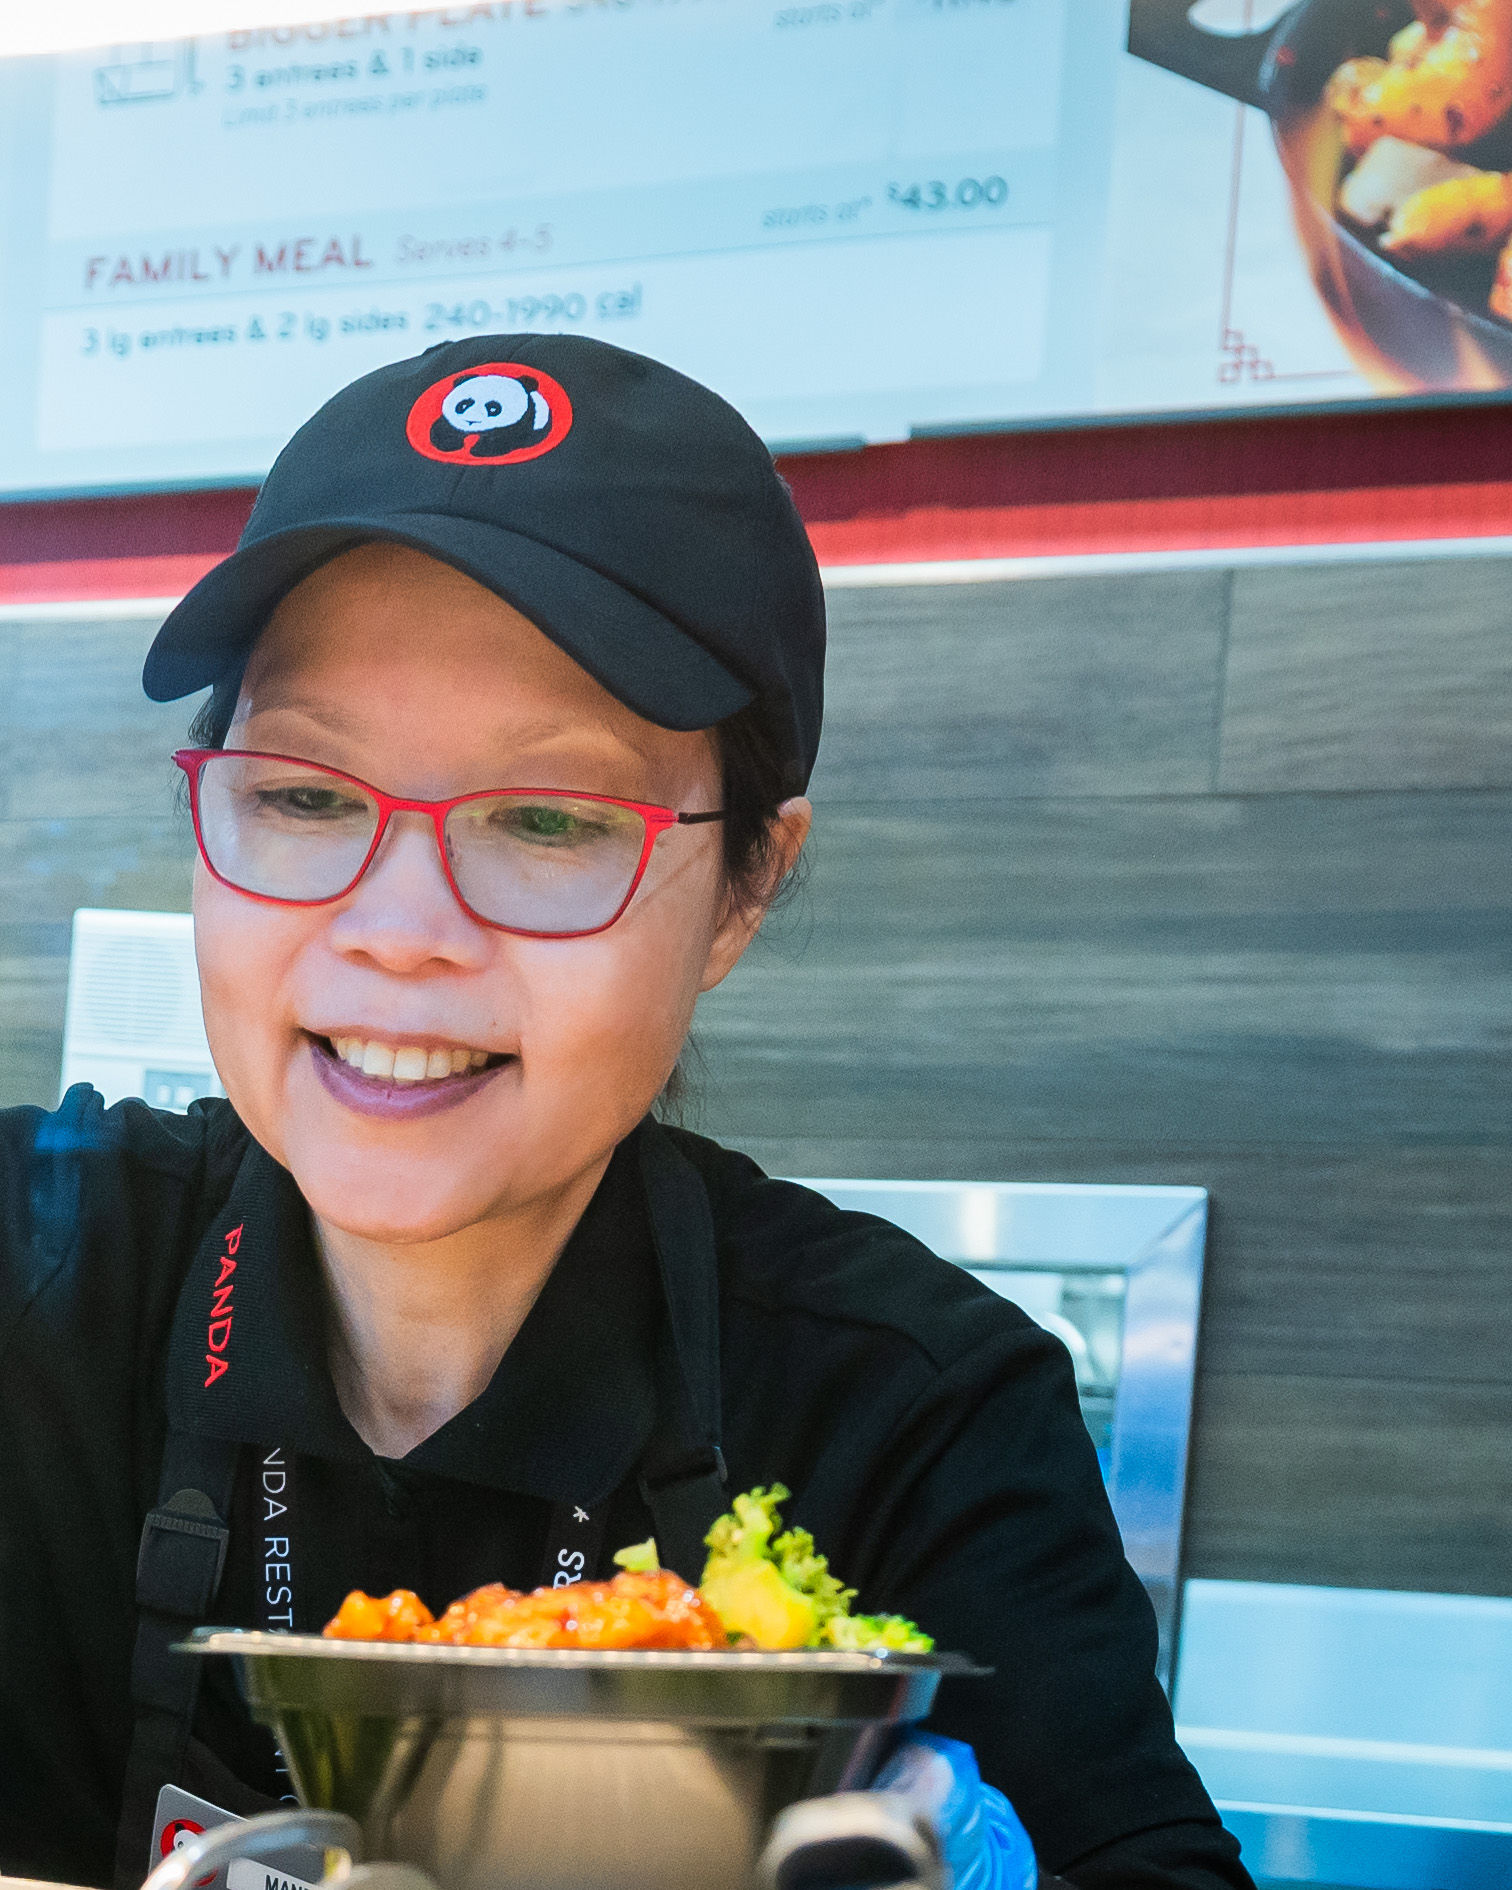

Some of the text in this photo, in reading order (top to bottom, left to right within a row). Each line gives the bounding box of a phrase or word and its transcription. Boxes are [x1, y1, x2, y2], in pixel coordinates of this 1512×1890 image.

[225, 63, 244, 91] 3
[255, 59, 358, 88] entrees
[370, 48, 390, 75] &
[423, 40, 482, 71] side
[885, 174, 1010, 211] $43.00
[84, 244, 241, 291] FAMILY
[252, 235, 375, 277] MEAL
[83, 326, 102, 355] 3
[139, 323, 237, 350] entrees
[247, 314, 266, 341] &
[278, 311, 298, 339] 2
[339, 306, 408, 334] sides
[594, 281, 644, 320] cal
[204, 1223, 244, 1388] PANDA
[264, 1537, 294, 1634] REST
